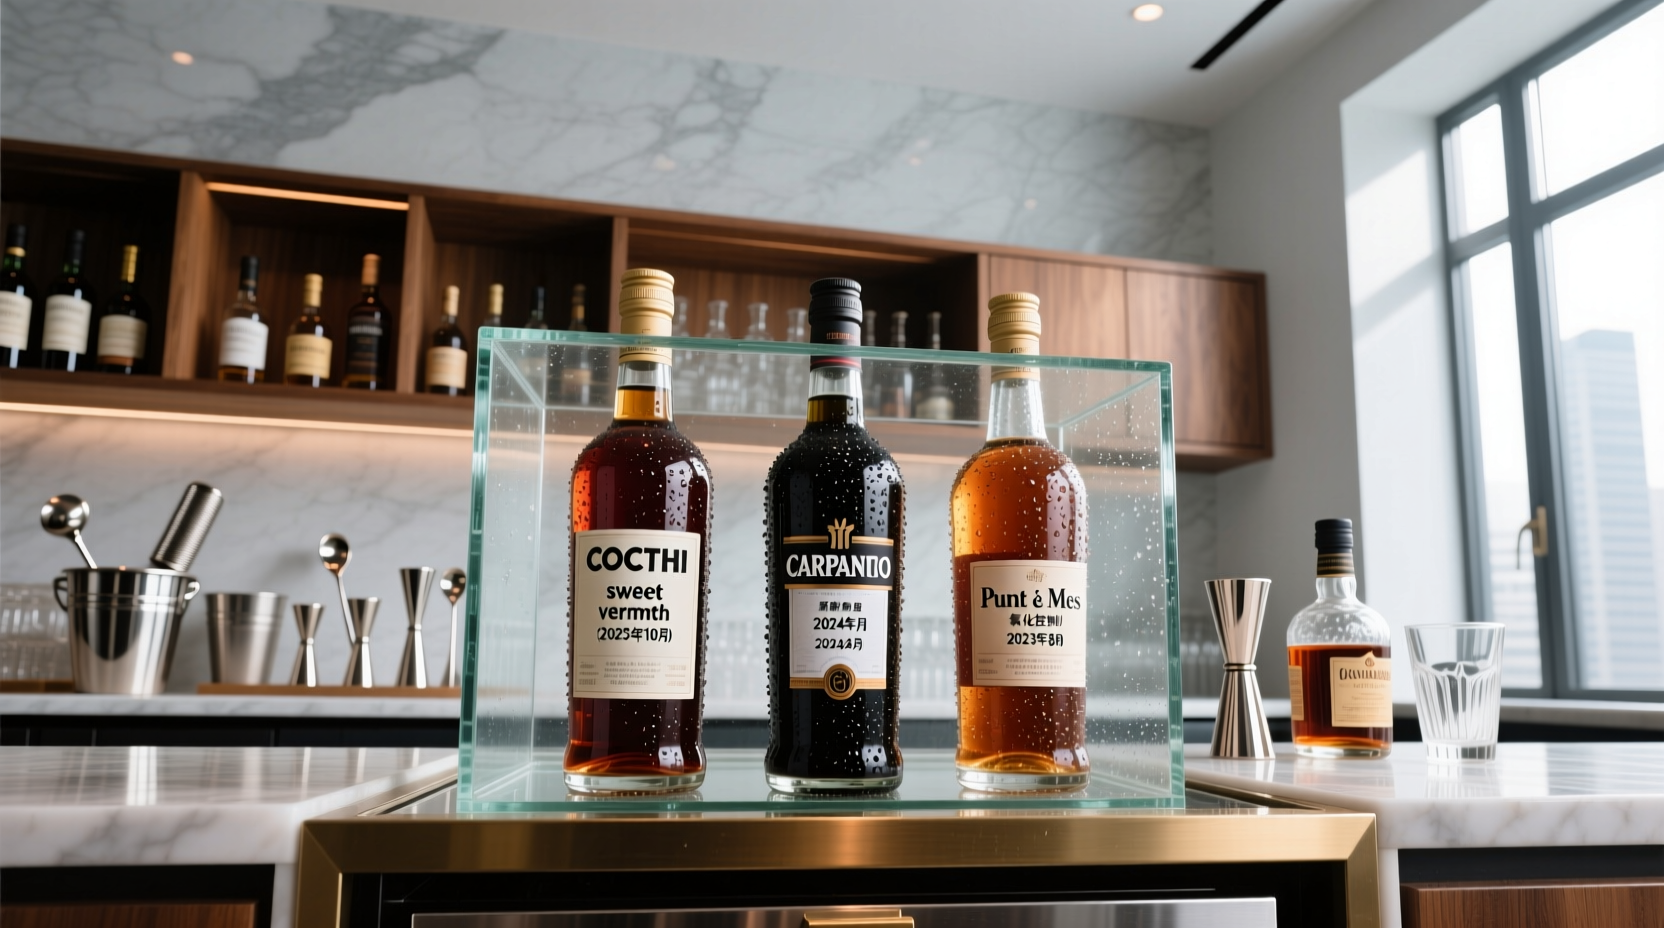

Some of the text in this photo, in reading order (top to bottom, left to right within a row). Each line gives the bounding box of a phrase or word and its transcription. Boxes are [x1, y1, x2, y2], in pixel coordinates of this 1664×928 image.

[586, 546, 688, 574] COCTHI
[606, 584, 664, 600] sweet
[980, 587, 1027, 608] Punt
[1047, 587, 1081, 610] Mes
[596, 626, 672, 643] (2025年10月)
